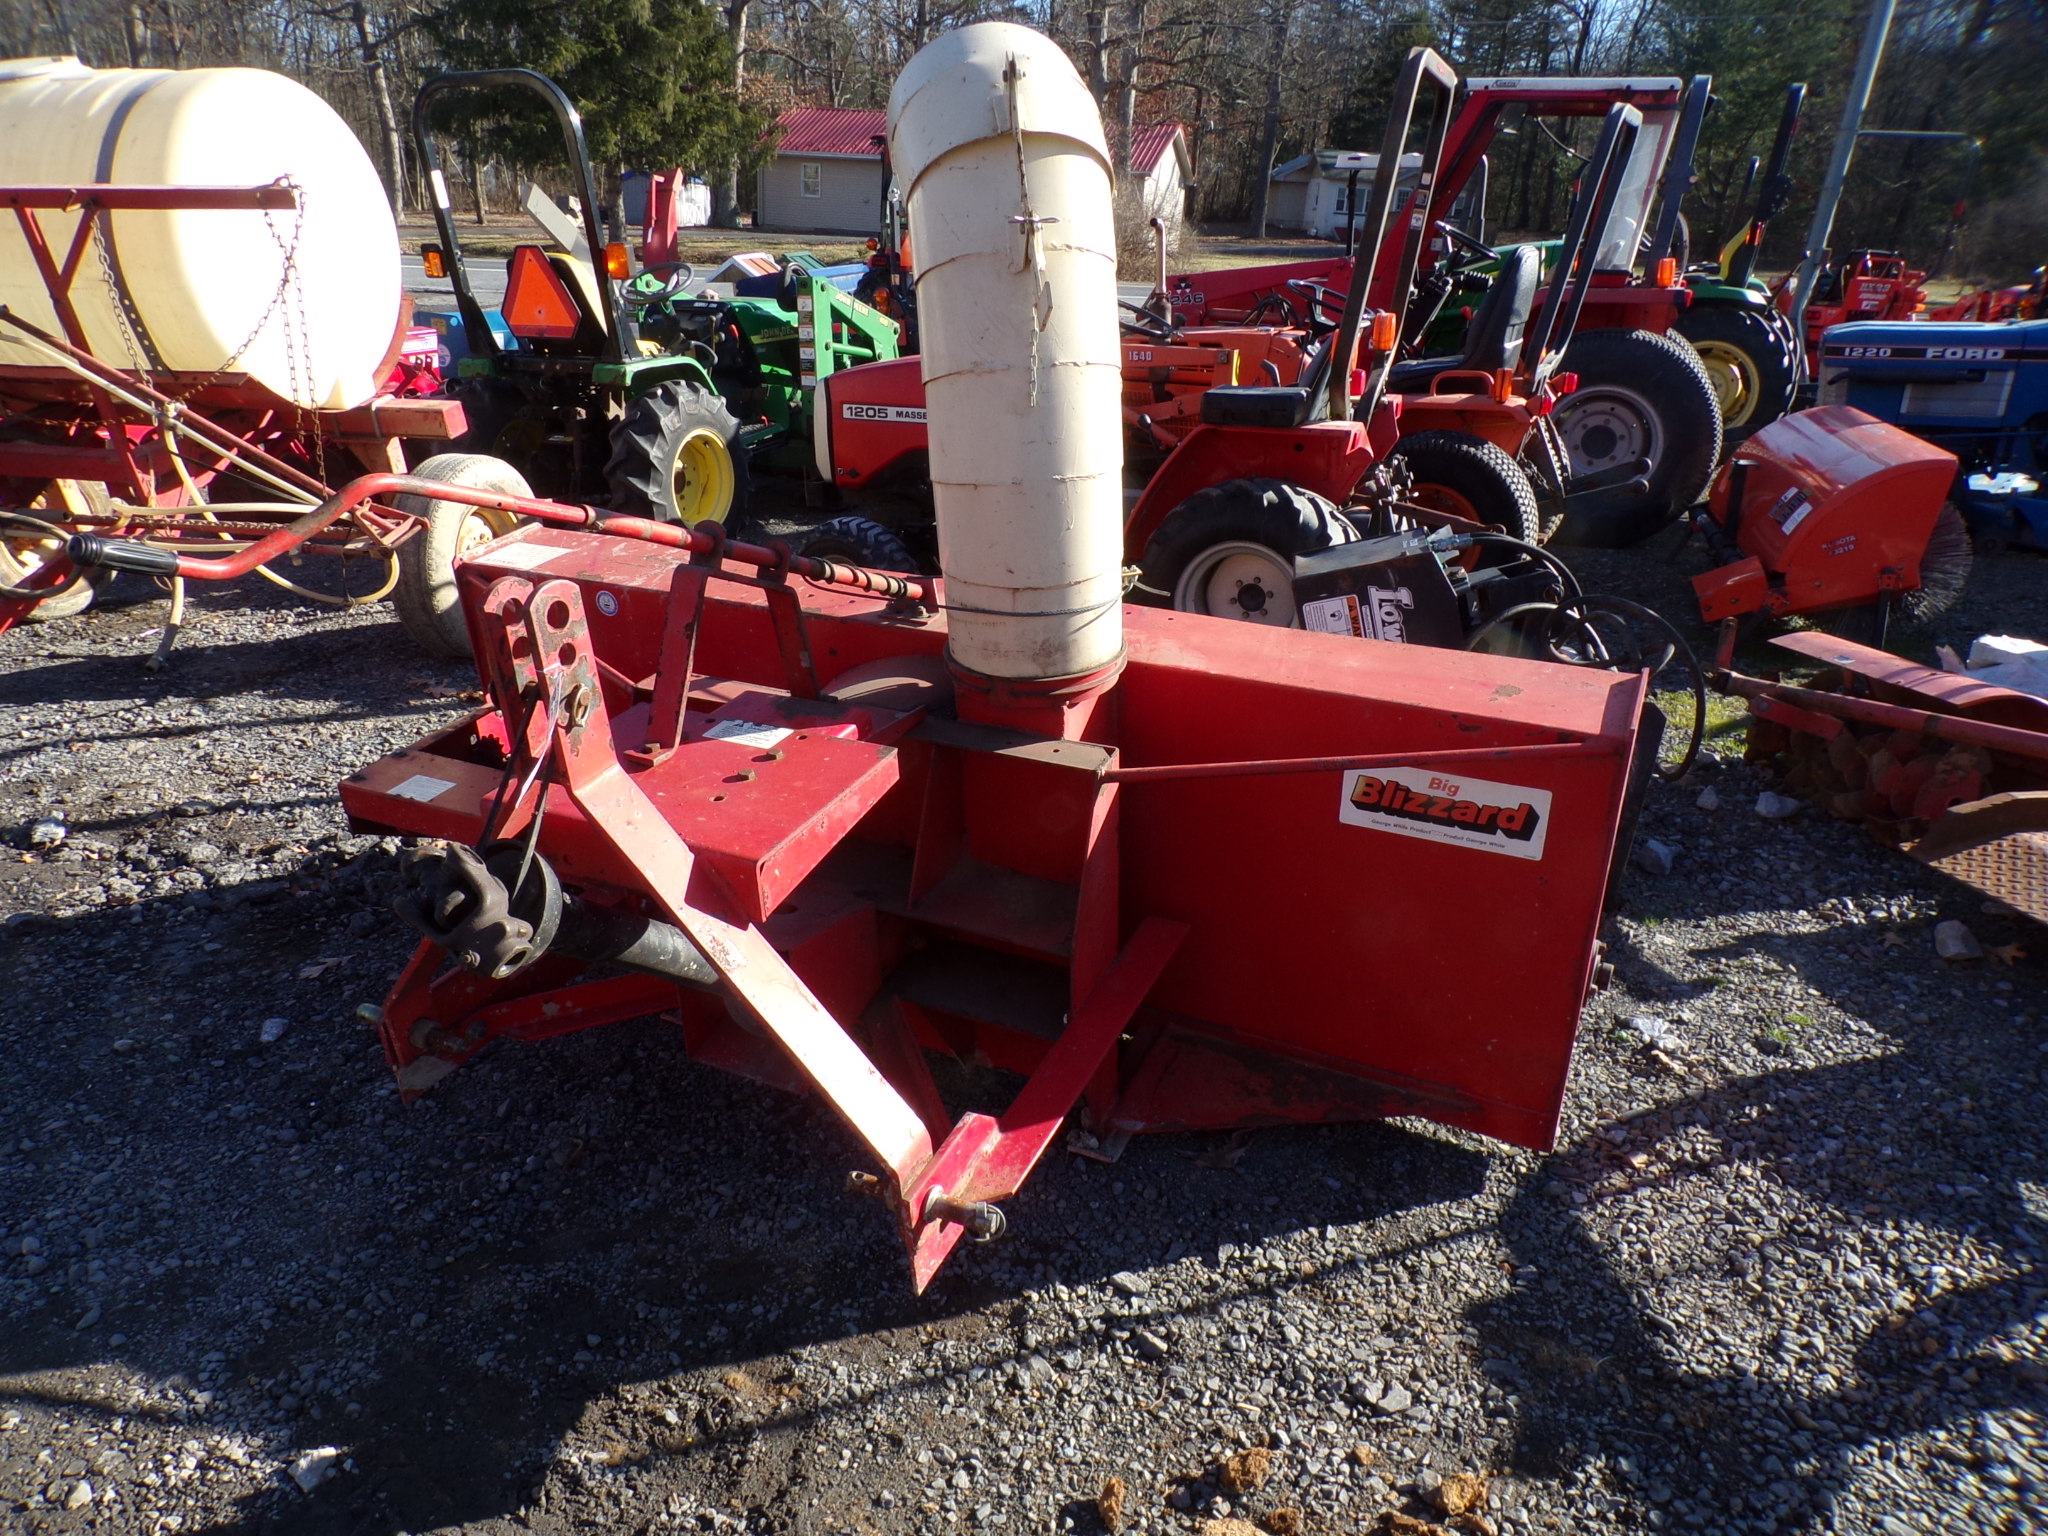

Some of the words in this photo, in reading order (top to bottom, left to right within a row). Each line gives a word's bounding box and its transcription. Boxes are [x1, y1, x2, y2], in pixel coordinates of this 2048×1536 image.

[1170, 293, 1204, 306] 246
[1129, 351, 1152, 361] 1640
[1844, 348, 1892, 358] 1220
[1925, 348, 2005, 360] FORD
[847, 406, 888, 418] 1205
[896, 410, 927, 420] MASSE
[1367, 586, 1414, 642] Low
[1427, 777, 1460, 796] Big
[1351, 775, 1540, 840] Blizzard
[1371, 818, 1391, 828] George
[1393, 822, 1408, 831] White
[1410, 827, 1431, 835] Product
[1443, 833, 1464, 842] Product
[1465, 837, 1487, 846] George
[1489, 841, 1505, 849] White
